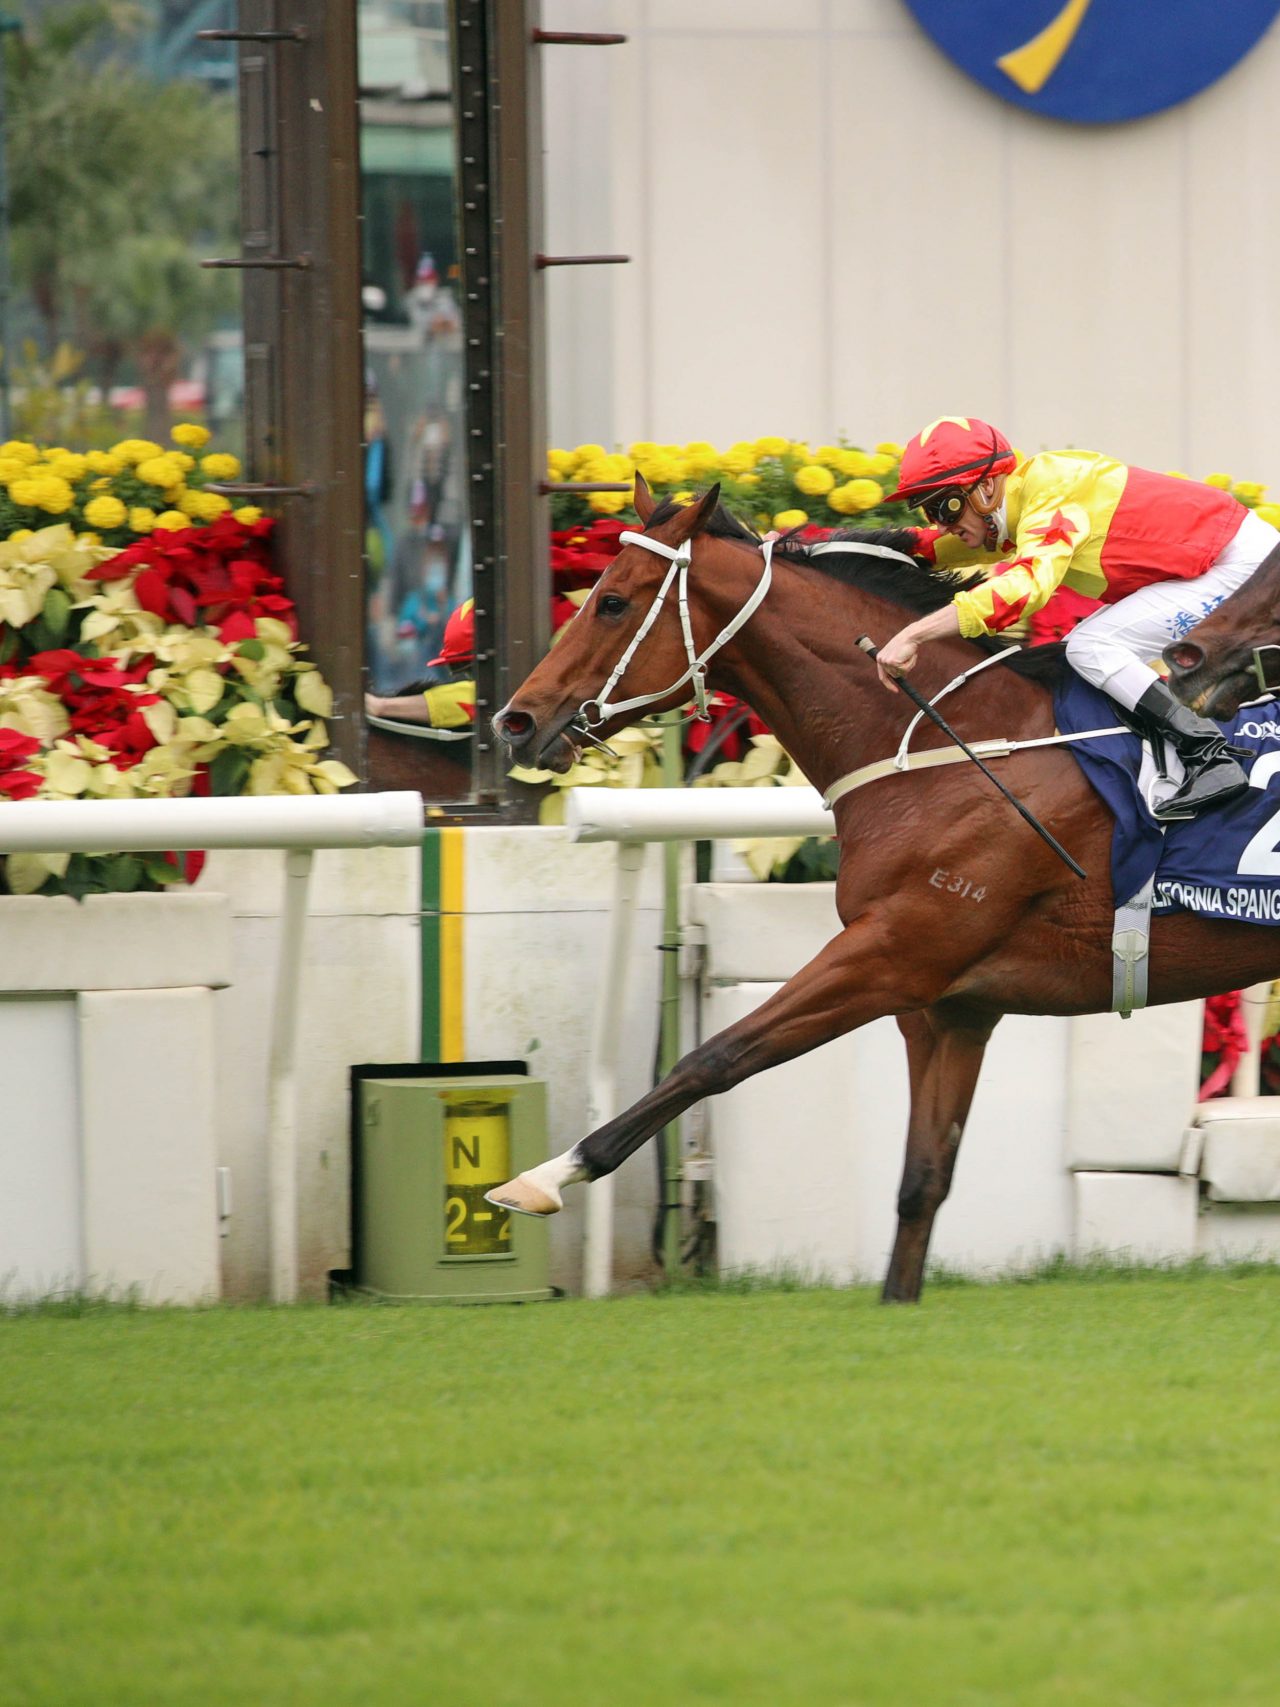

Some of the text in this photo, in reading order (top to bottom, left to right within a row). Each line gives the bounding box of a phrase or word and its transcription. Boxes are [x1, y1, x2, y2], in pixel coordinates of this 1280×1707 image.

[928, 867, 988, 904] E314
[1150, 881, 1224, 914] LIFORNIA
[452, 1135, 481, 1169] N
